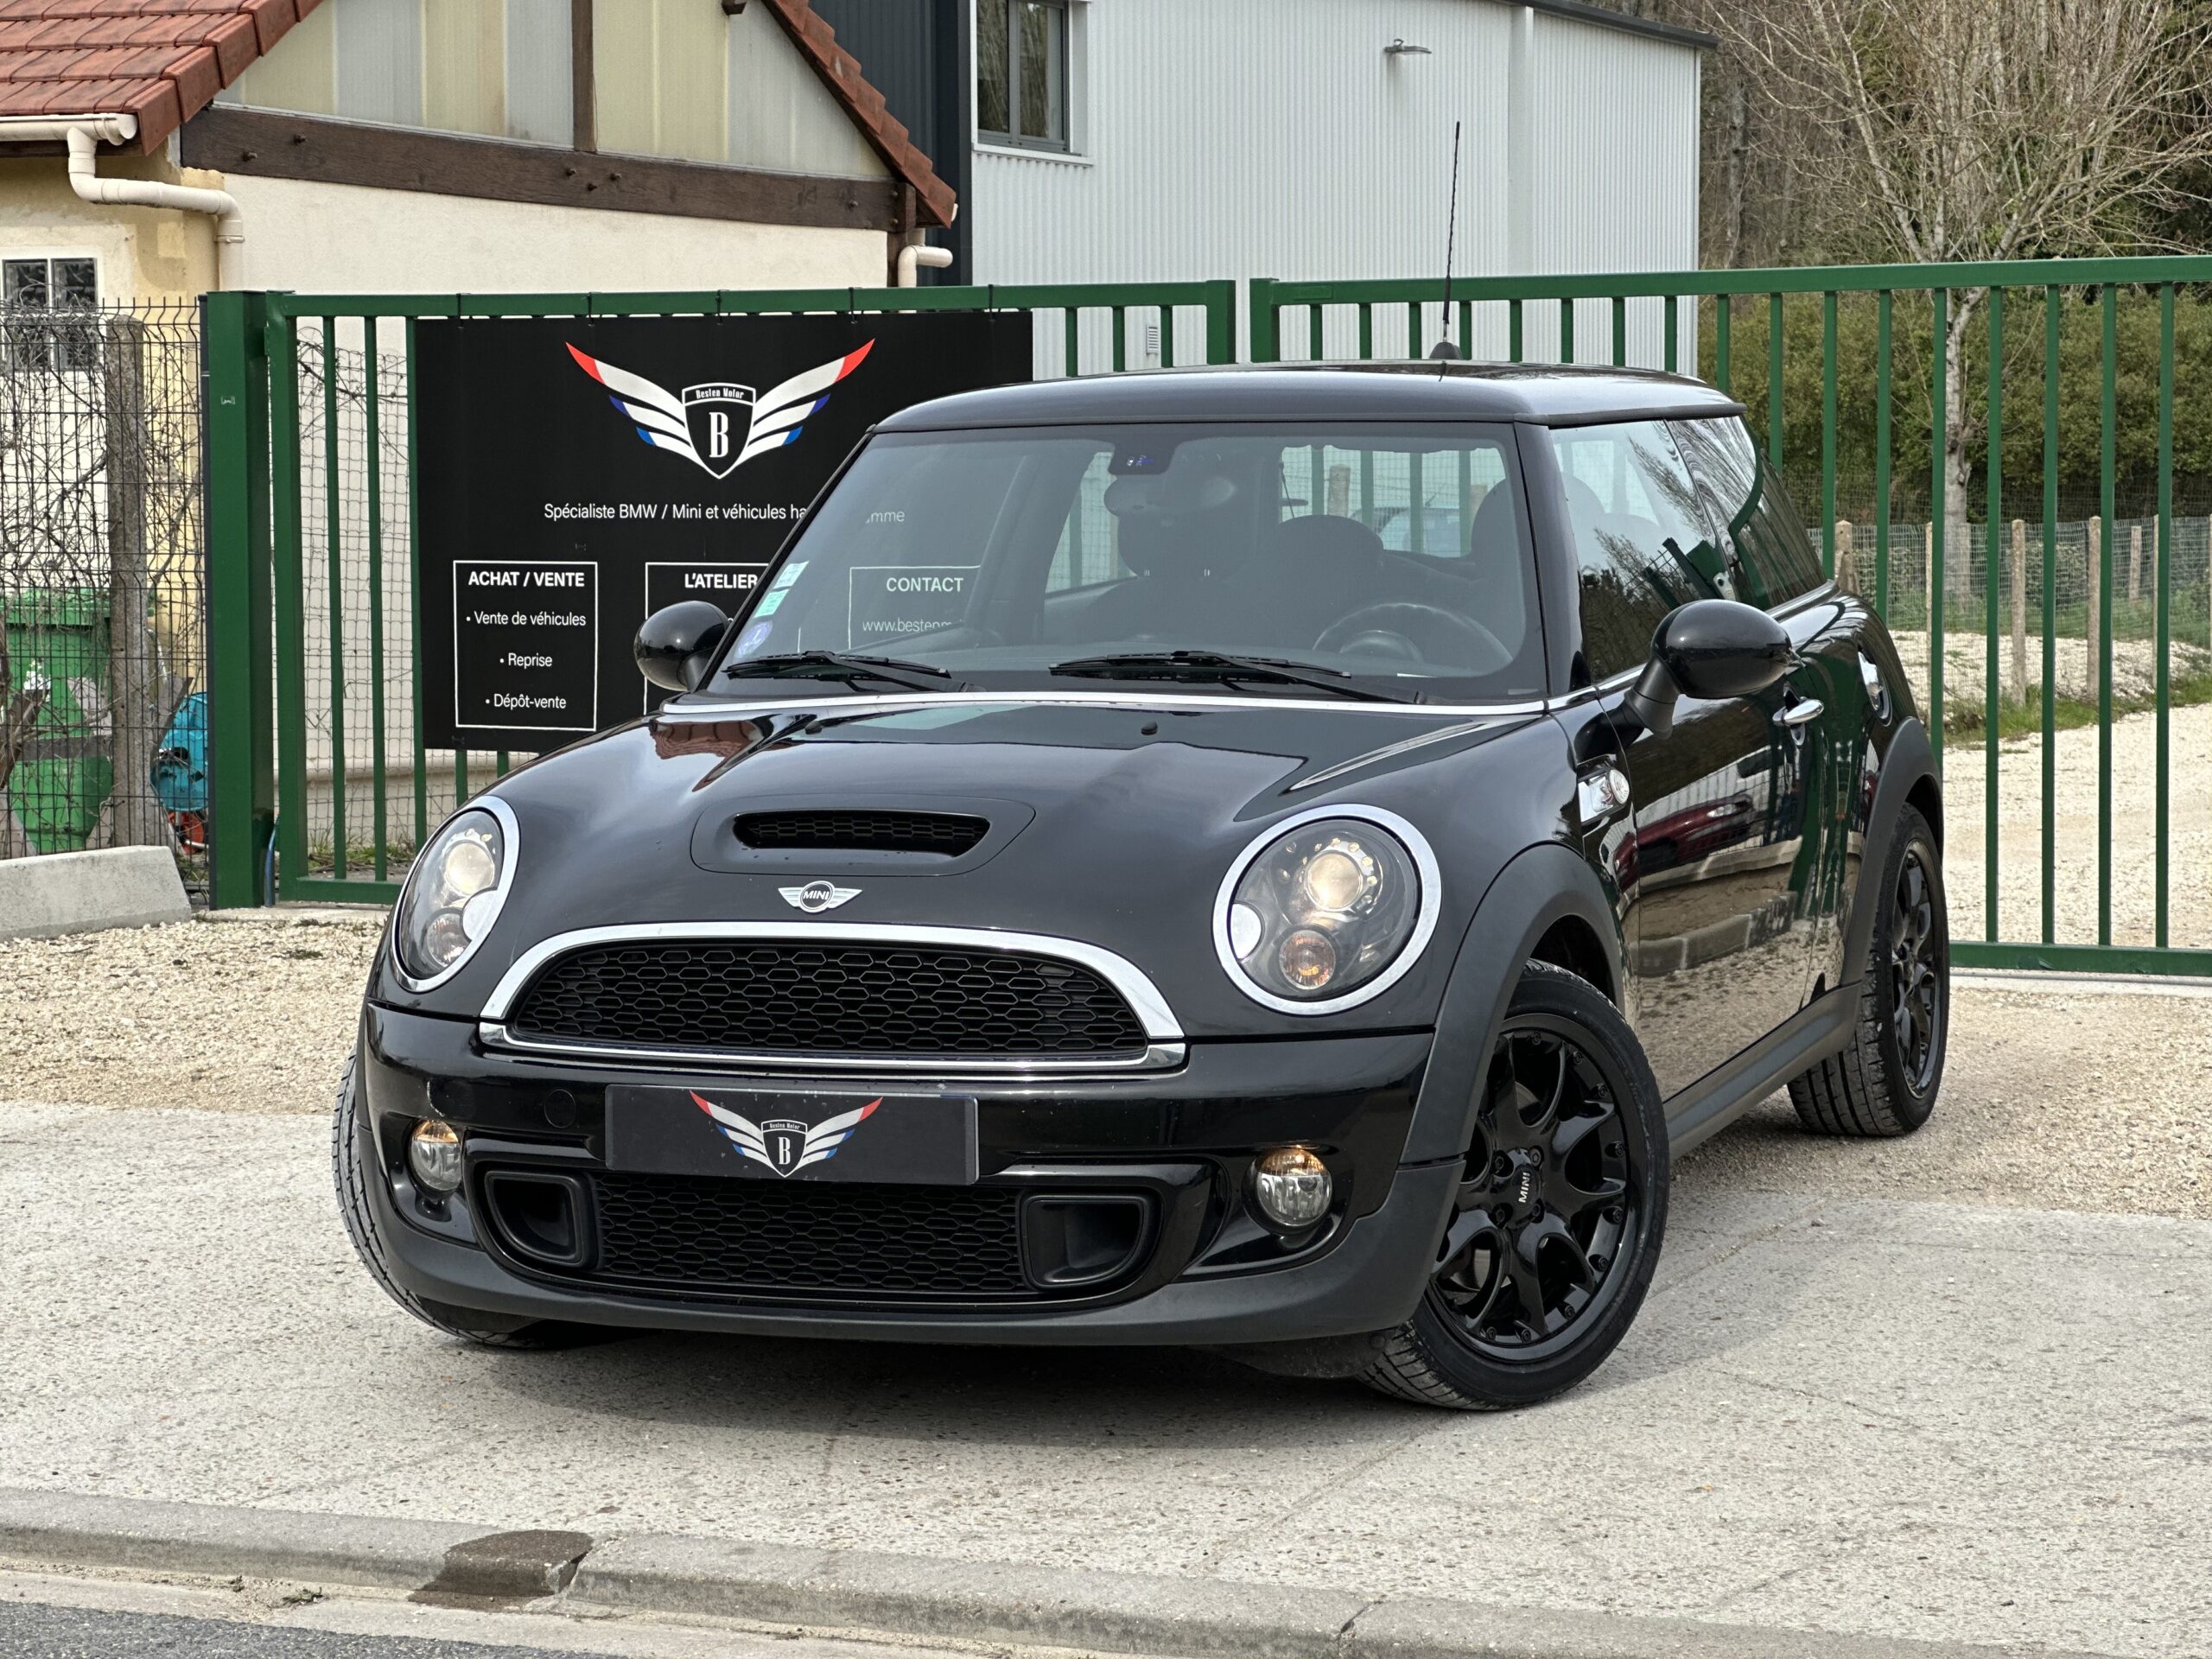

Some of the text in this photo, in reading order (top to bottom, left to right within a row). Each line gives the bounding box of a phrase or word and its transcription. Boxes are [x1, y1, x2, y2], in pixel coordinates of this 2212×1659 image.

[709, 411, 728, 459] B
[543, 503, 615, 522] Spécialiste
[619, 503, 658, 518] BMW
[672, 503, 702, 519] Mini
[705, 505, 719, 519] et
[721, 503, 787, 520] véhicules
[791, 503, 807, 519] ha
[865, 511, 906, 524] mme
[467, 570, 520, 587] ACHAT
[533, 572, 585, 588] VENTE
[886, 577, 964, 593] CONTACT
[474, 610, 587, 626] Vente de véhicules
[508, 652, 553, 670] Reprise
[493, 693, 567, 710] Dépôt-vente
[803, 890, 830, 900] MINI
[778, 1136, 791, 1165] B
[1518, 1172, 1530, 1203] MINI
